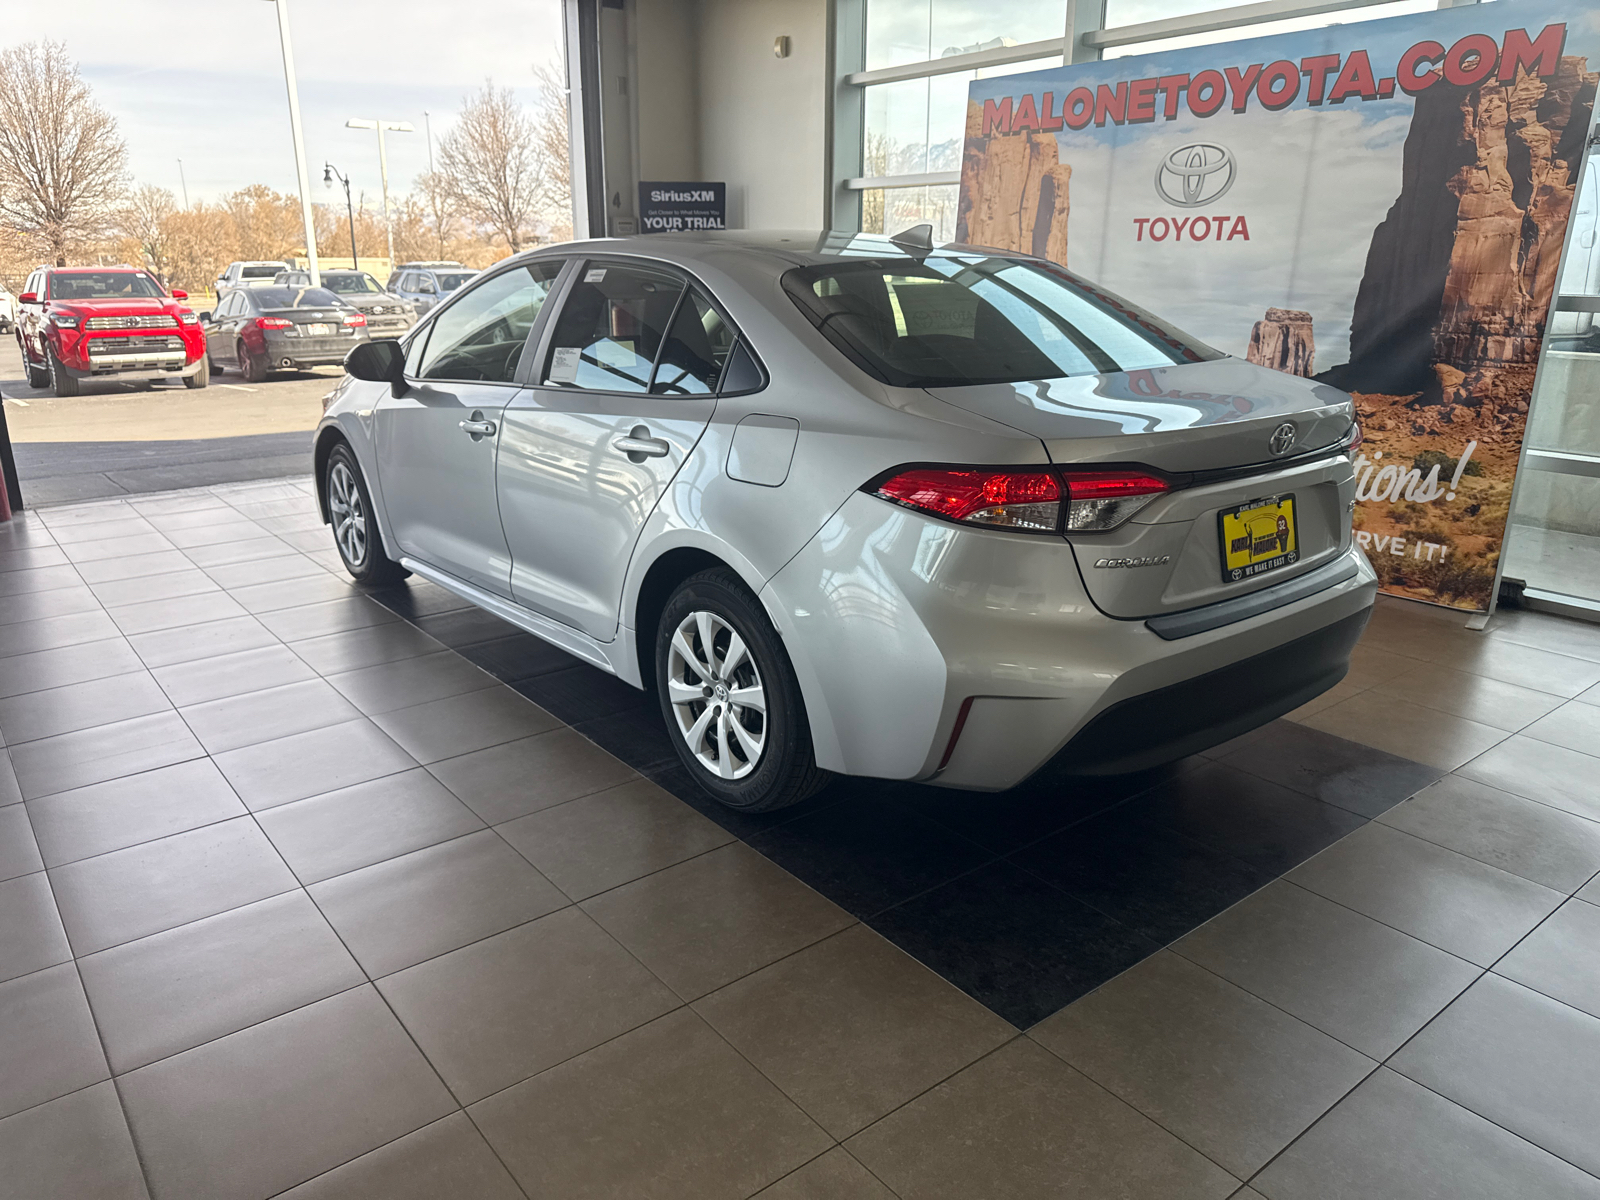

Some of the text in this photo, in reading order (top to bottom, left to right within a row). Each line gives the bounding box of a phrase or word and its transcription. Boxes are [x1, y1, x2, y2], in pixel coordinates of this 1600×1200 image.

[982, 22, 1568, 138] MALONETOYOTA.COM
[612, 191, 621, 209] 4
[651, 190, 715, 202] SiriusXM
[644, 217, 682, 228] YOUR
[684, 217, 725, 229] TRIAL
[1133, 216, 1250, 242] TOYOTA
[1278, 519, 1286, 530] 32
[1352, 529, 1448, 564] RVE IT!
[1093, 554, 1170, 568] COROLLA
[1245, 566, 1254, 576] WE
[1254, 562, 1268, 574] MAKE
[1273, 556, 1285, 567] EASY
